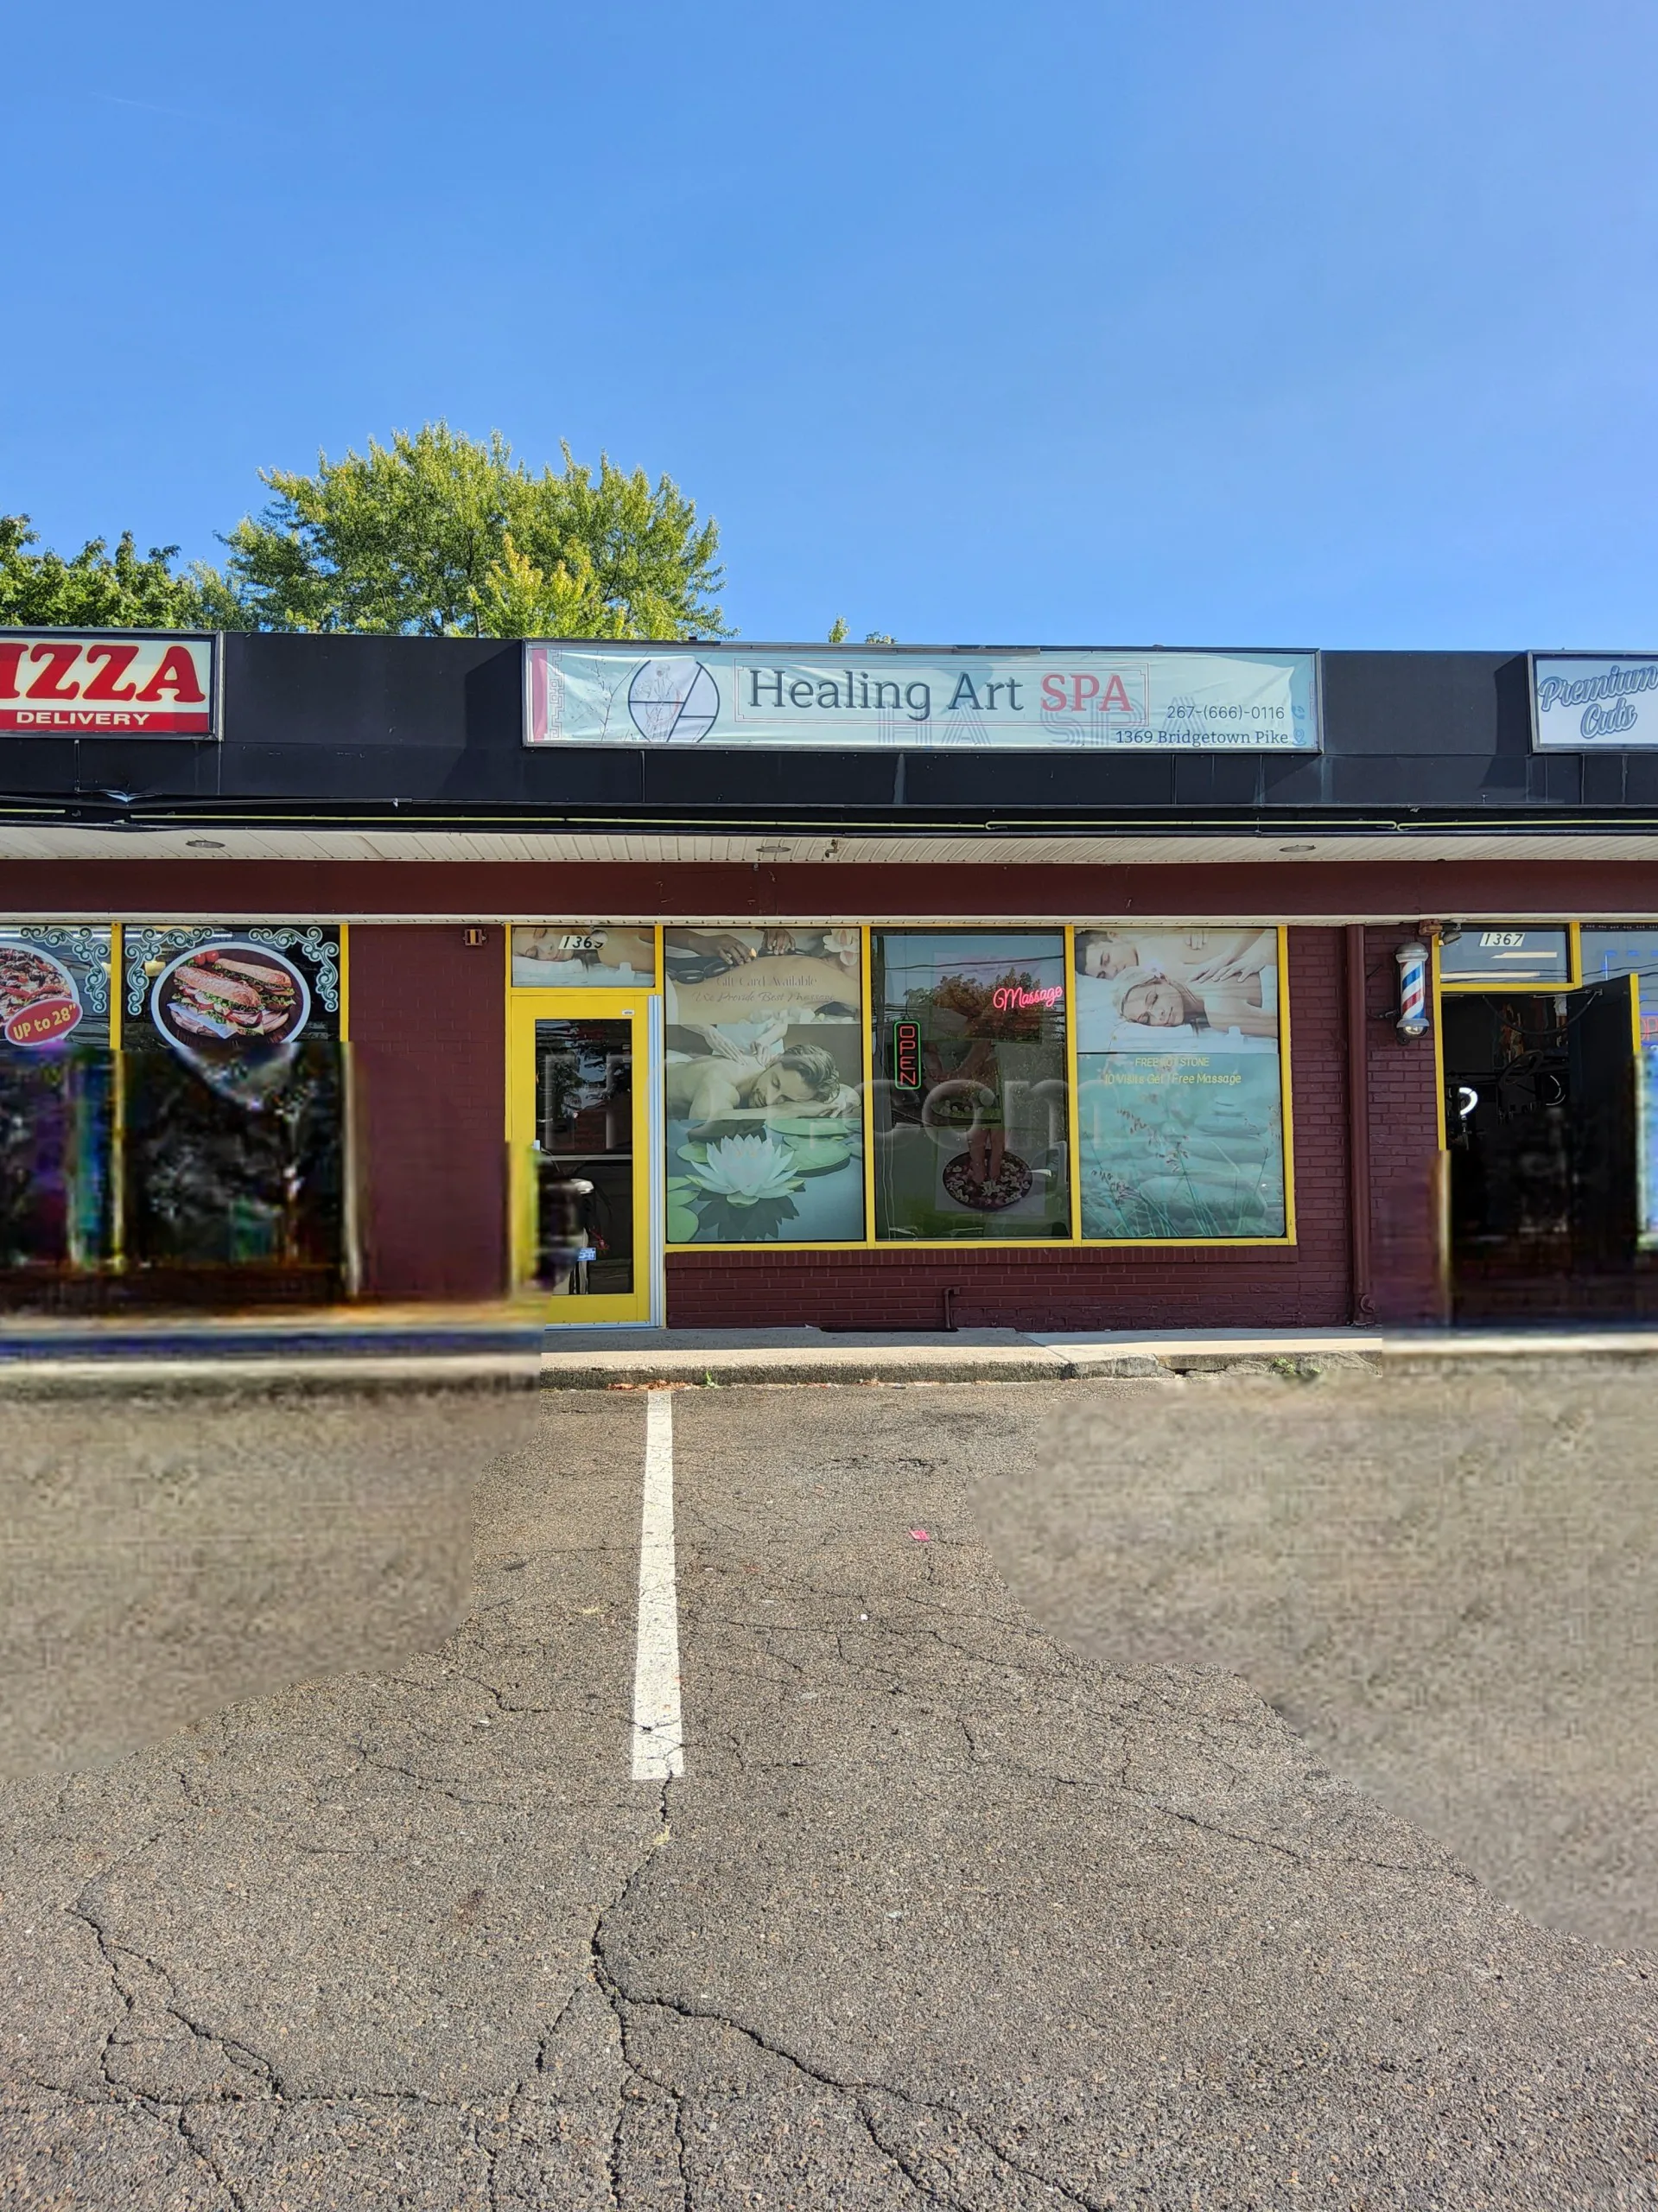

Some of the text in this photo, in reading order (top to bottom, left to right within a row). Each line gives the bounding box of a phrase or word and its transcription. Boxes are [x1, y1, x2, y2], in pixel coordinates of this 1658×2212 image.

[748, 670, 1134, 721] Healing Art SPA
[1538, 665, 1658, 712] Premium
[16, 712, 149, 725] DELIVERY
[1166, 705, 1285, 721] 267-(666)-0116
[1580, 698, 1637, 739] Cuts
[1115, 730, 1288, 747] 1369 Bridgetown Pike
[1484, 933, 1523, 945] 1367
[771, 975, 817, 987] Available
[993, 986, 1063, 1011] Massage
[13, 1022, 31, 1040] UP
[34, 1018, 51, 1033] to
[899, 1026, 916, 1085] OPEN
[1135, 1058, 1159, 1066] FREE
[1179, 1057, 1210, 1066] STONE
[1172, 1073, 1194, 1084] Free
[1197, 1073, 1242, 1085] Massage
